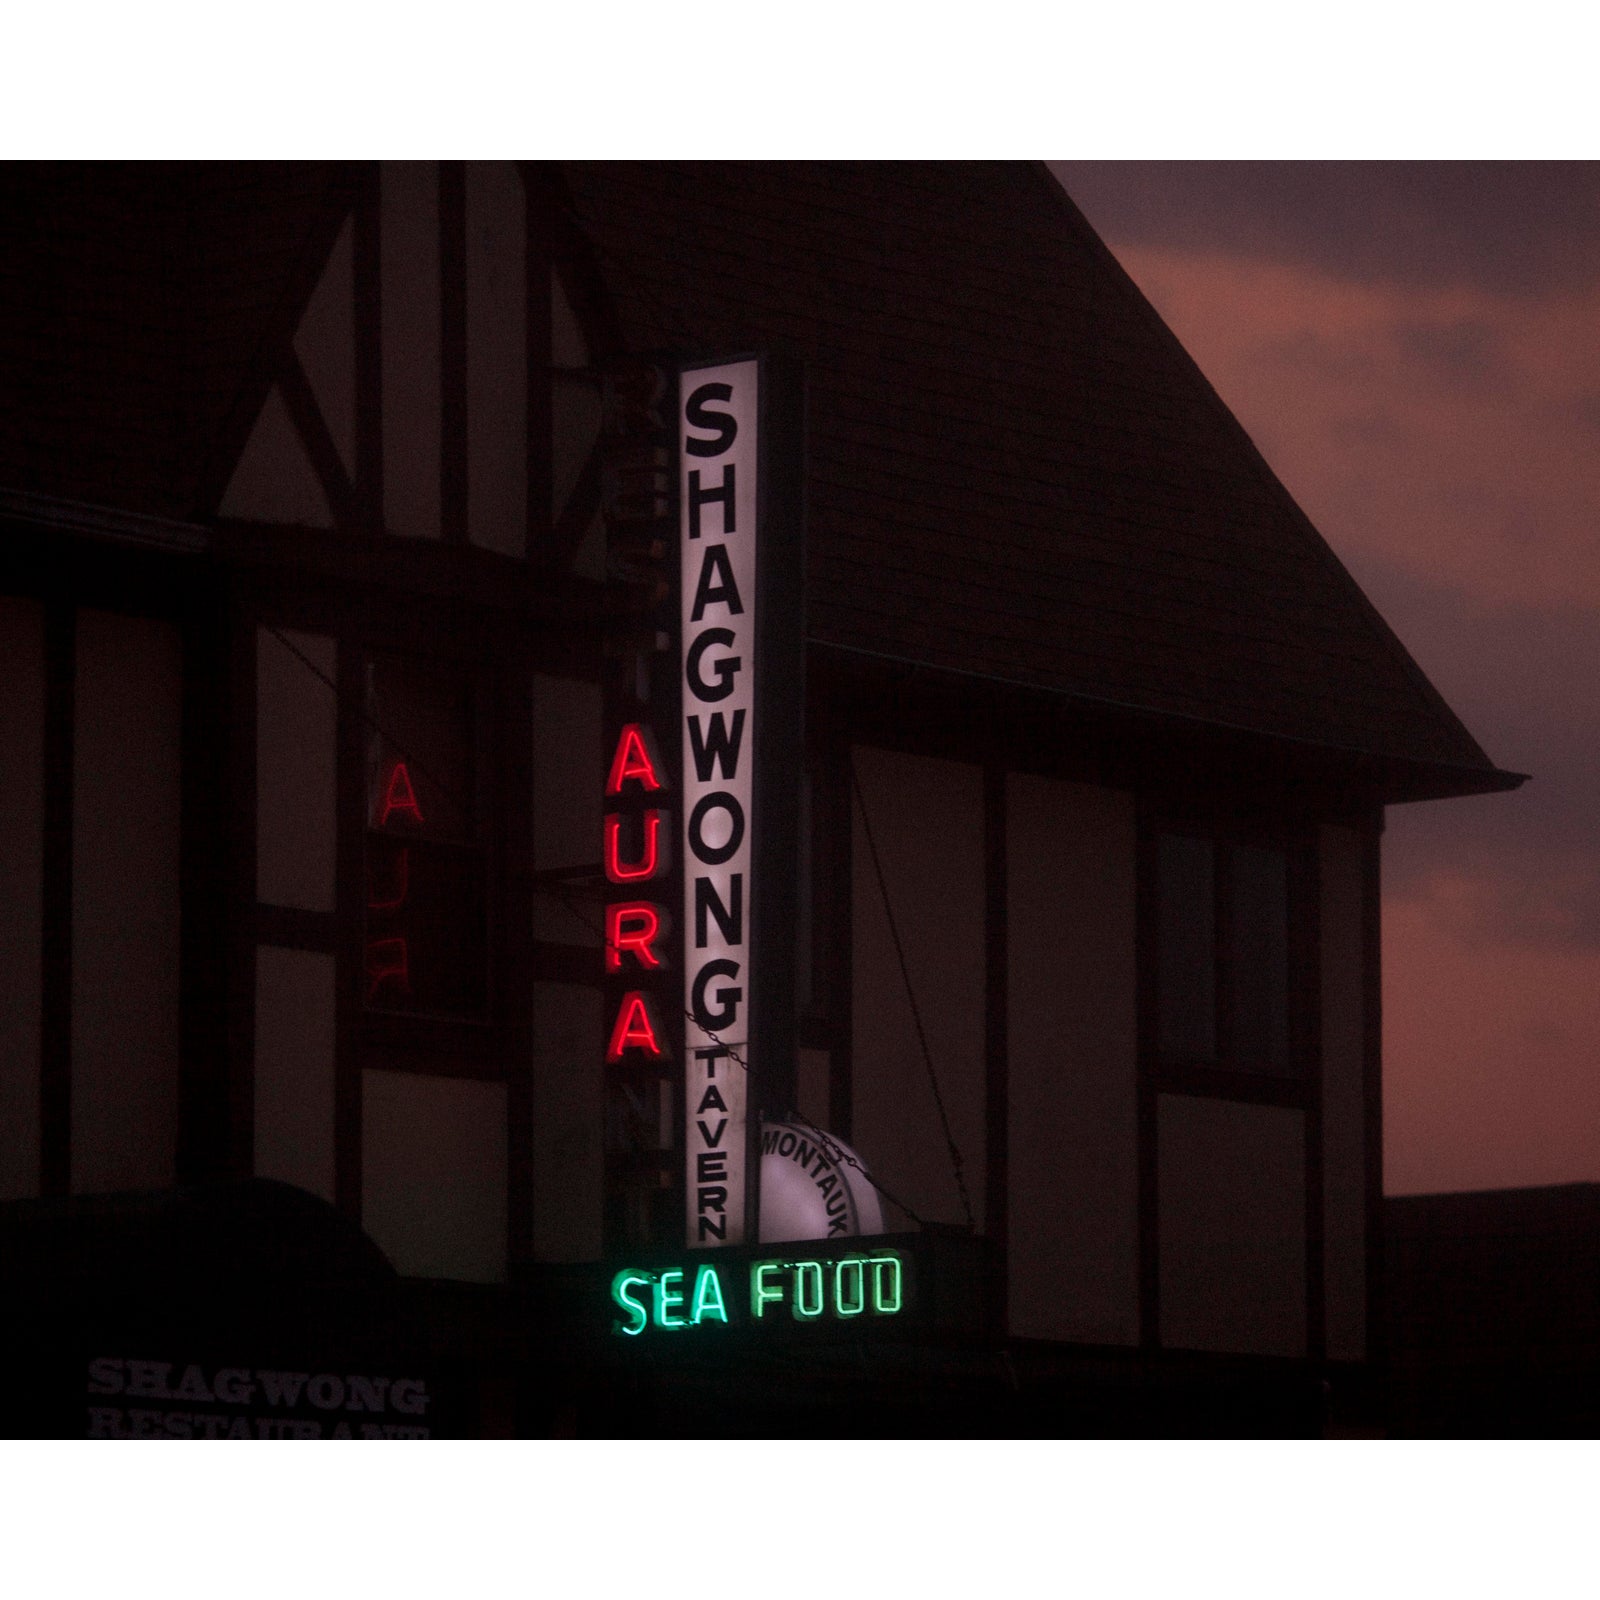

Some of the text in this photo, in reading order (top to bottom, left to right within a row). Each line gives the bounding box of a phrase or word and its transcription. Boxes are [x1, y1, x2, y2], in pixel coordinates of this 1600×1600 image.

[684, 382, 747, 1031] SHAGWONG
[696, 1049, 729, 1242] TAVERN
[759, 1130, 849, 1239] MONTAUK
[610, 1247, 904, 1337] SEA FOOD
[86, 1356, 432, 1416] SHAGWONG
